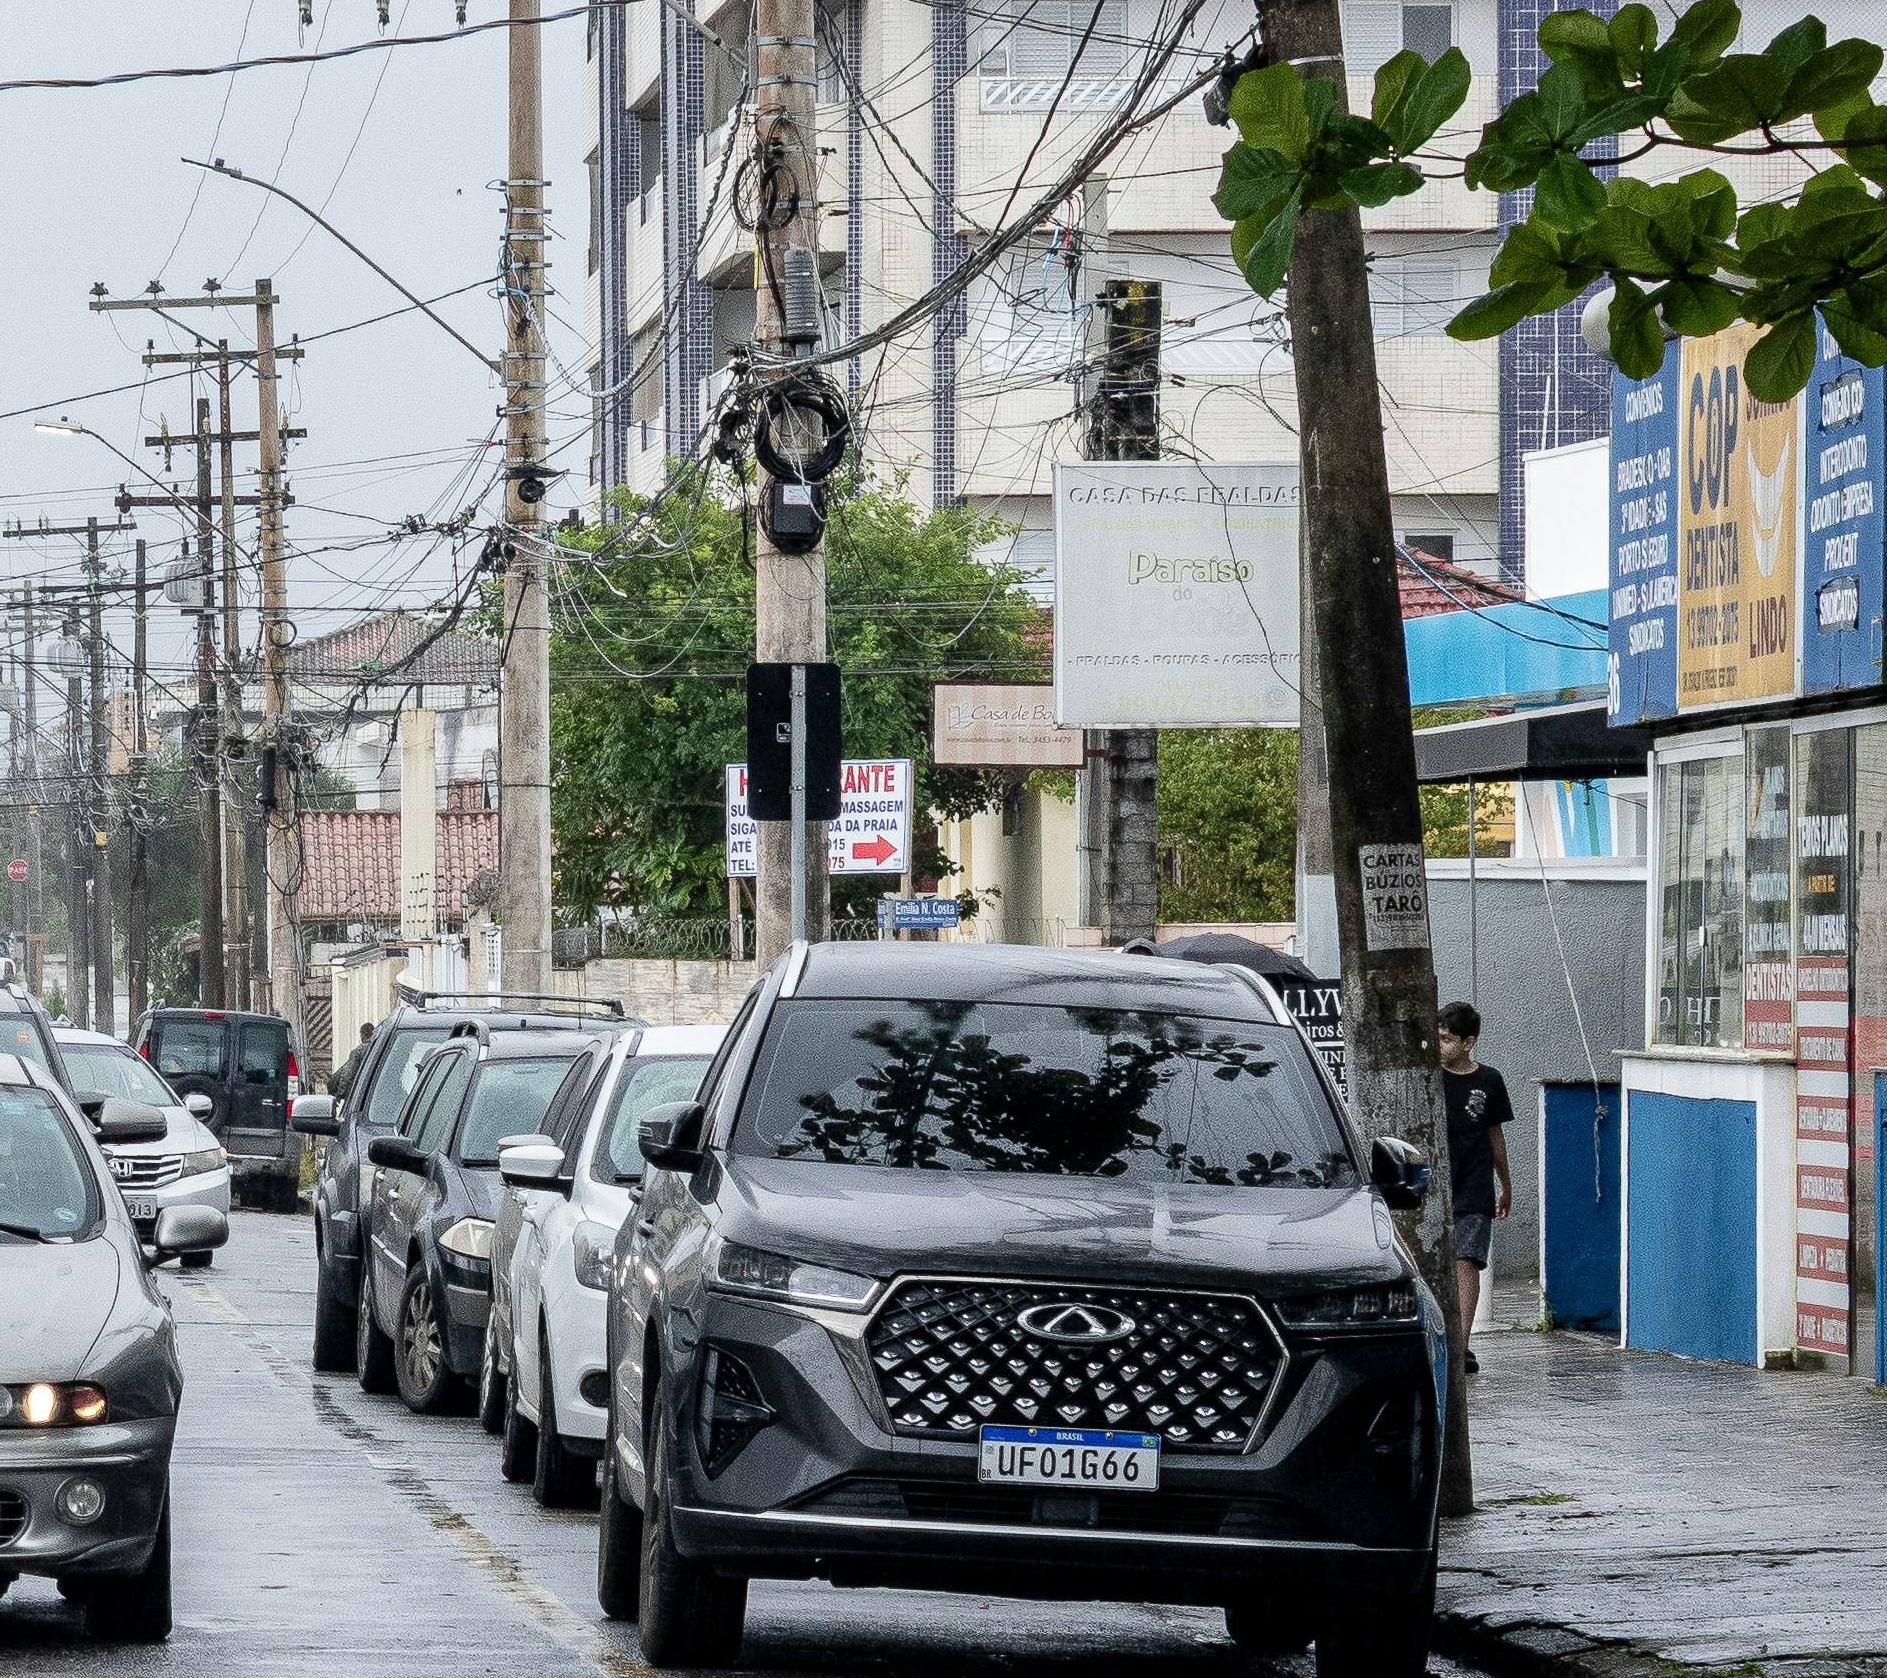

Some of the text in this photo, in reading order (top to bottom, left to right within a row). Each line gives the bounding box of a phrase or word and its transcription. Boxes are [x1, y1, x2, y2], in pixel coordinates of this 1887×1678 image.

[1688, 364, 1738, 515] COP
[1069, 487, 1131, 504] CASA
[1142, 487, 1187, 504] DAS
[1810, 490, 1840, 533] ODONTO
[1618, 540, 1640, 576] PORTO
[1686, 522, 1739, 591] DENTISTA
[1128, 547, 1254, 585] Paraíso
[1172, 587, 1192, 600] do
[1749, 594, 1787, 659] LINDO
[1076, 655, 1139, 666] FRALDAS
[1153, 654, 1211, 666] ROUPAS
[971, 705, 1055, 720] Casa de Bo
[730, 822, 757, 835] SIGA
[845, 819, 860, 832] DA
[863, 818, 898, 832] PRAIA
[1821, 813, 1848, 857] PLANOS
[731, 838, 752, 853] ATÉ
[731, 858, 755, 871] TEL:
[1363, 853, 1420, 869] CARTAS
[1365, 868, 1422, 891] BÚZIOS
[933, 902, 955, 915] Costa
[1746, 962, 1792, 1001] DENTISTAS
[1056, 1431, 1084, 1441] BRASIL
[981, 1468, 992, 1479] BR
